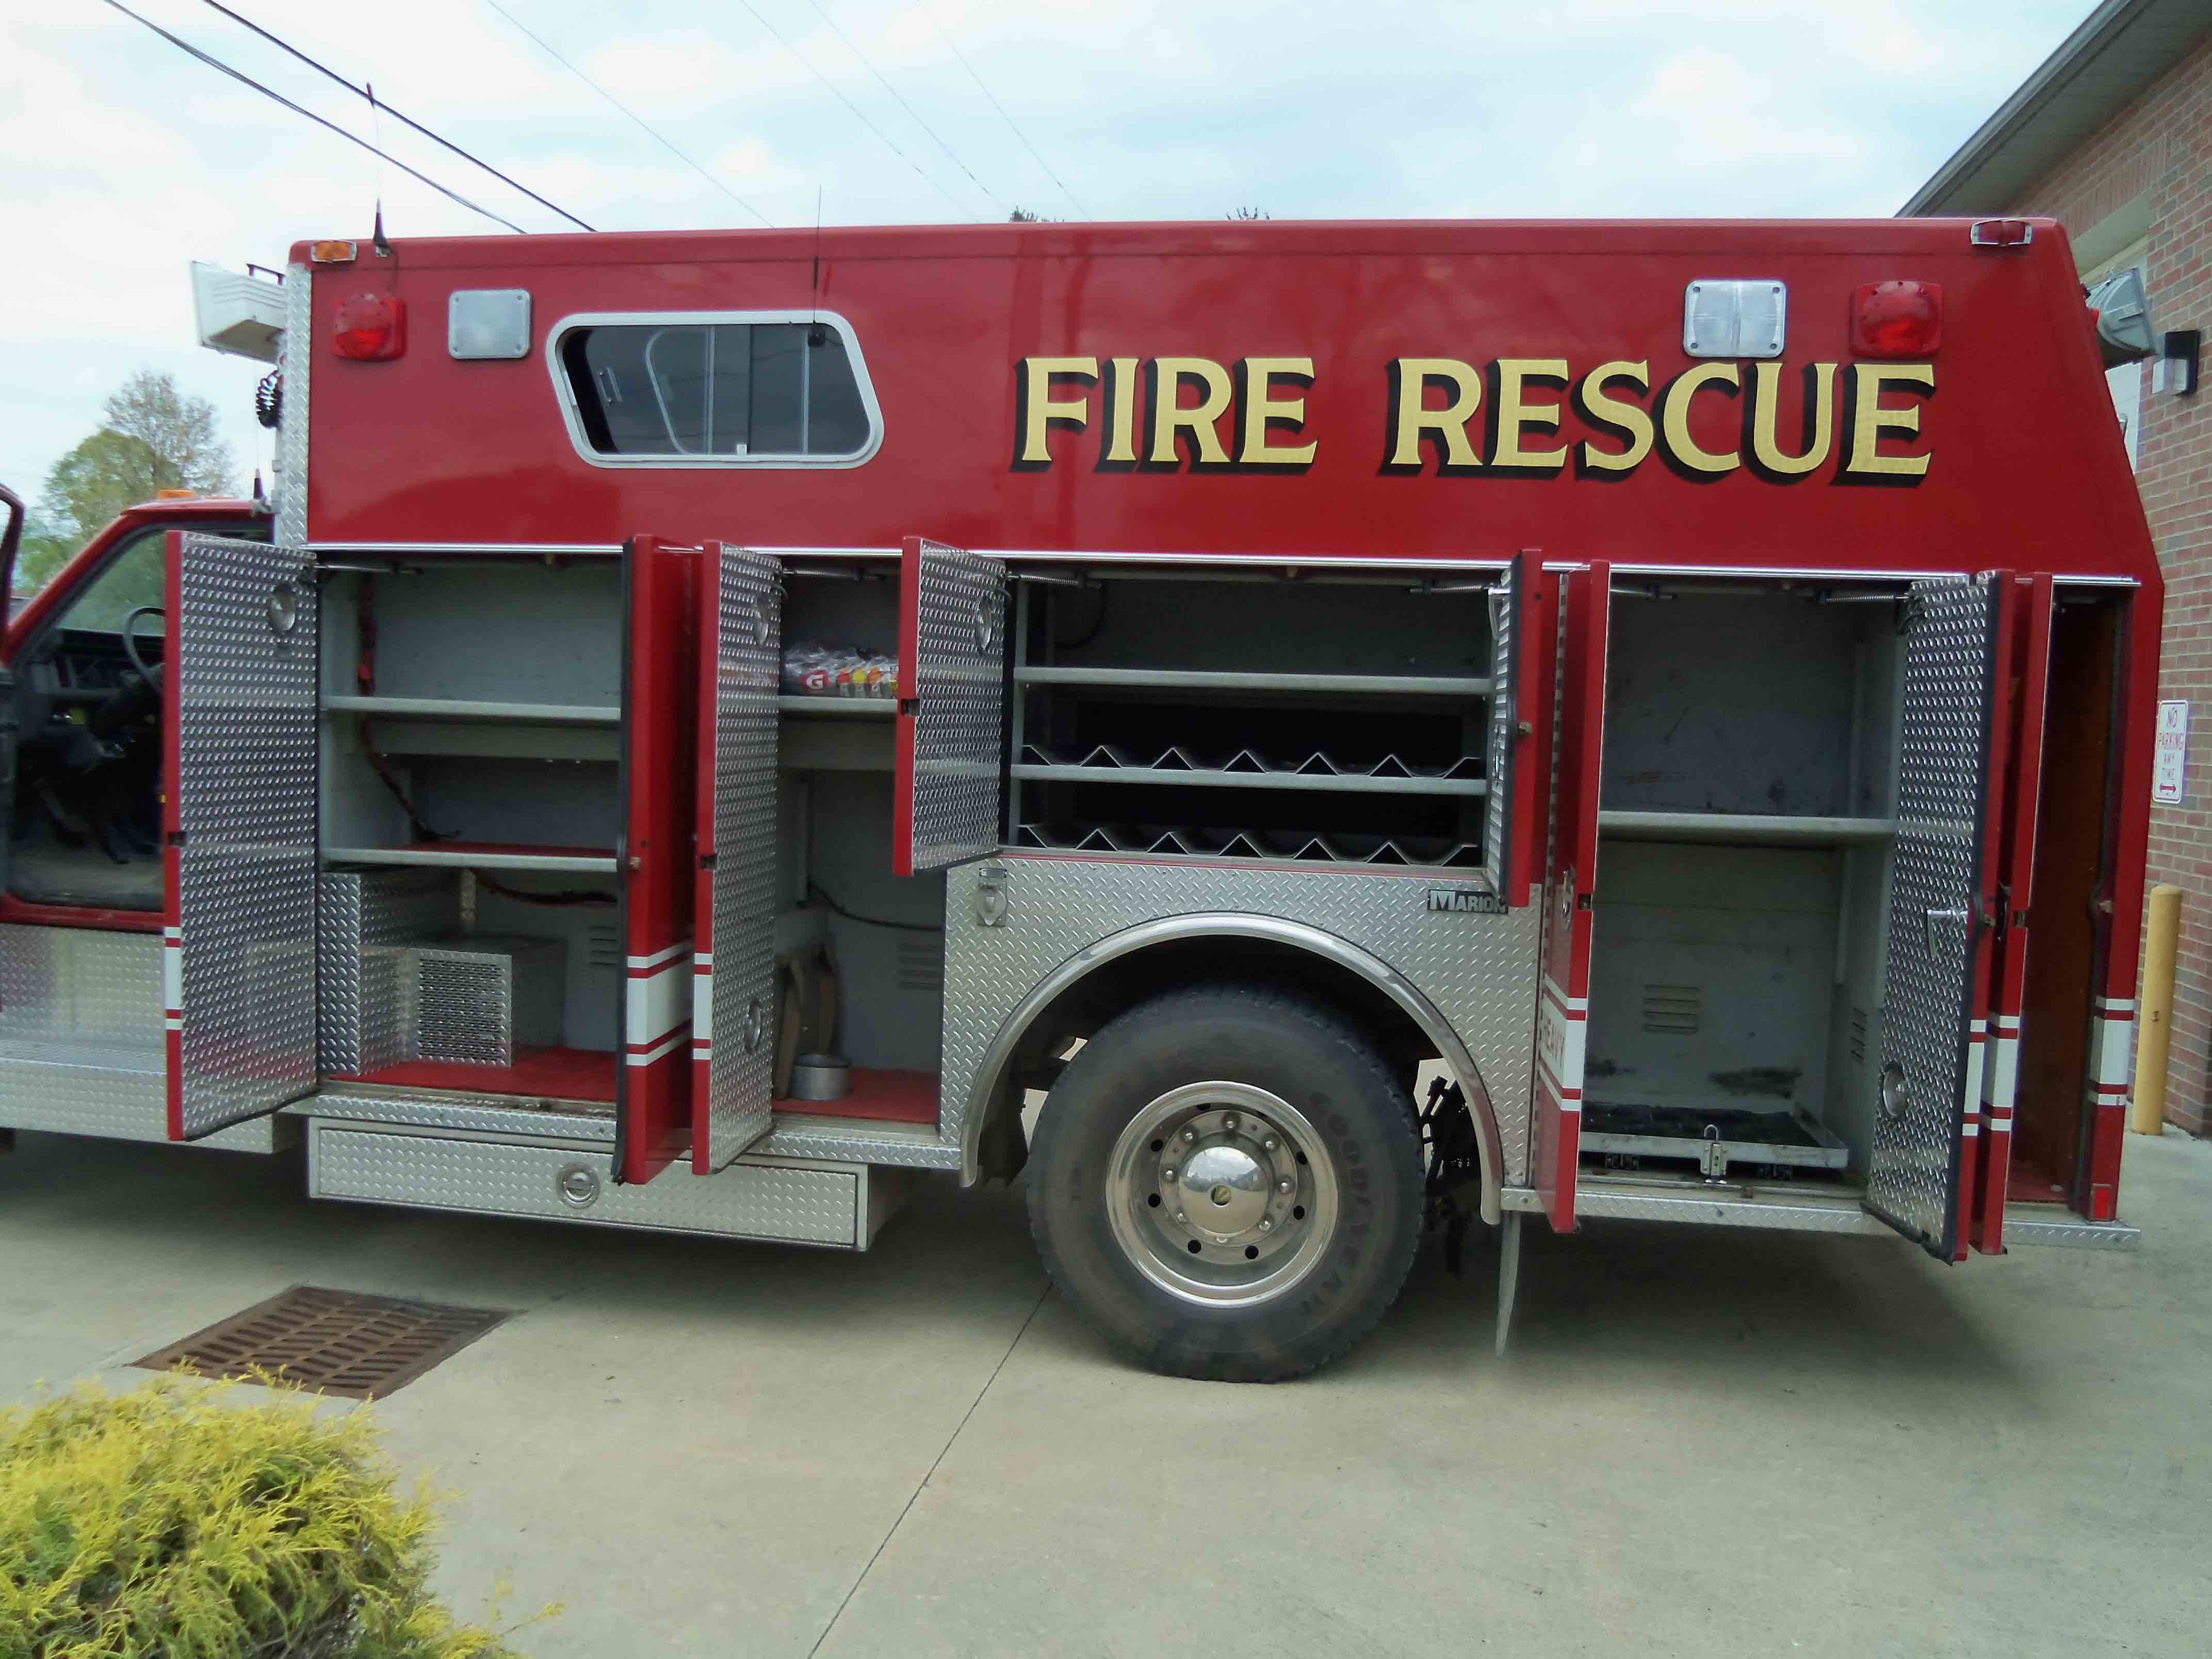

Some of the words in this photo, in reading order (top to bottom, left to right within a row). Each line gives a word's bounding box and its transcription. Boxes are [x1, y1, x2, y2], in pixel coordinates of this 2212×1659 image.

[1010, 356, 1318, 475] FIRE
[1379, 357, 1937, 486] RESCUE
[806, 675, 824, 690] G
[2166, 709, 2178, 728] NO
[2158, 733, 2183, 751] PARKING
